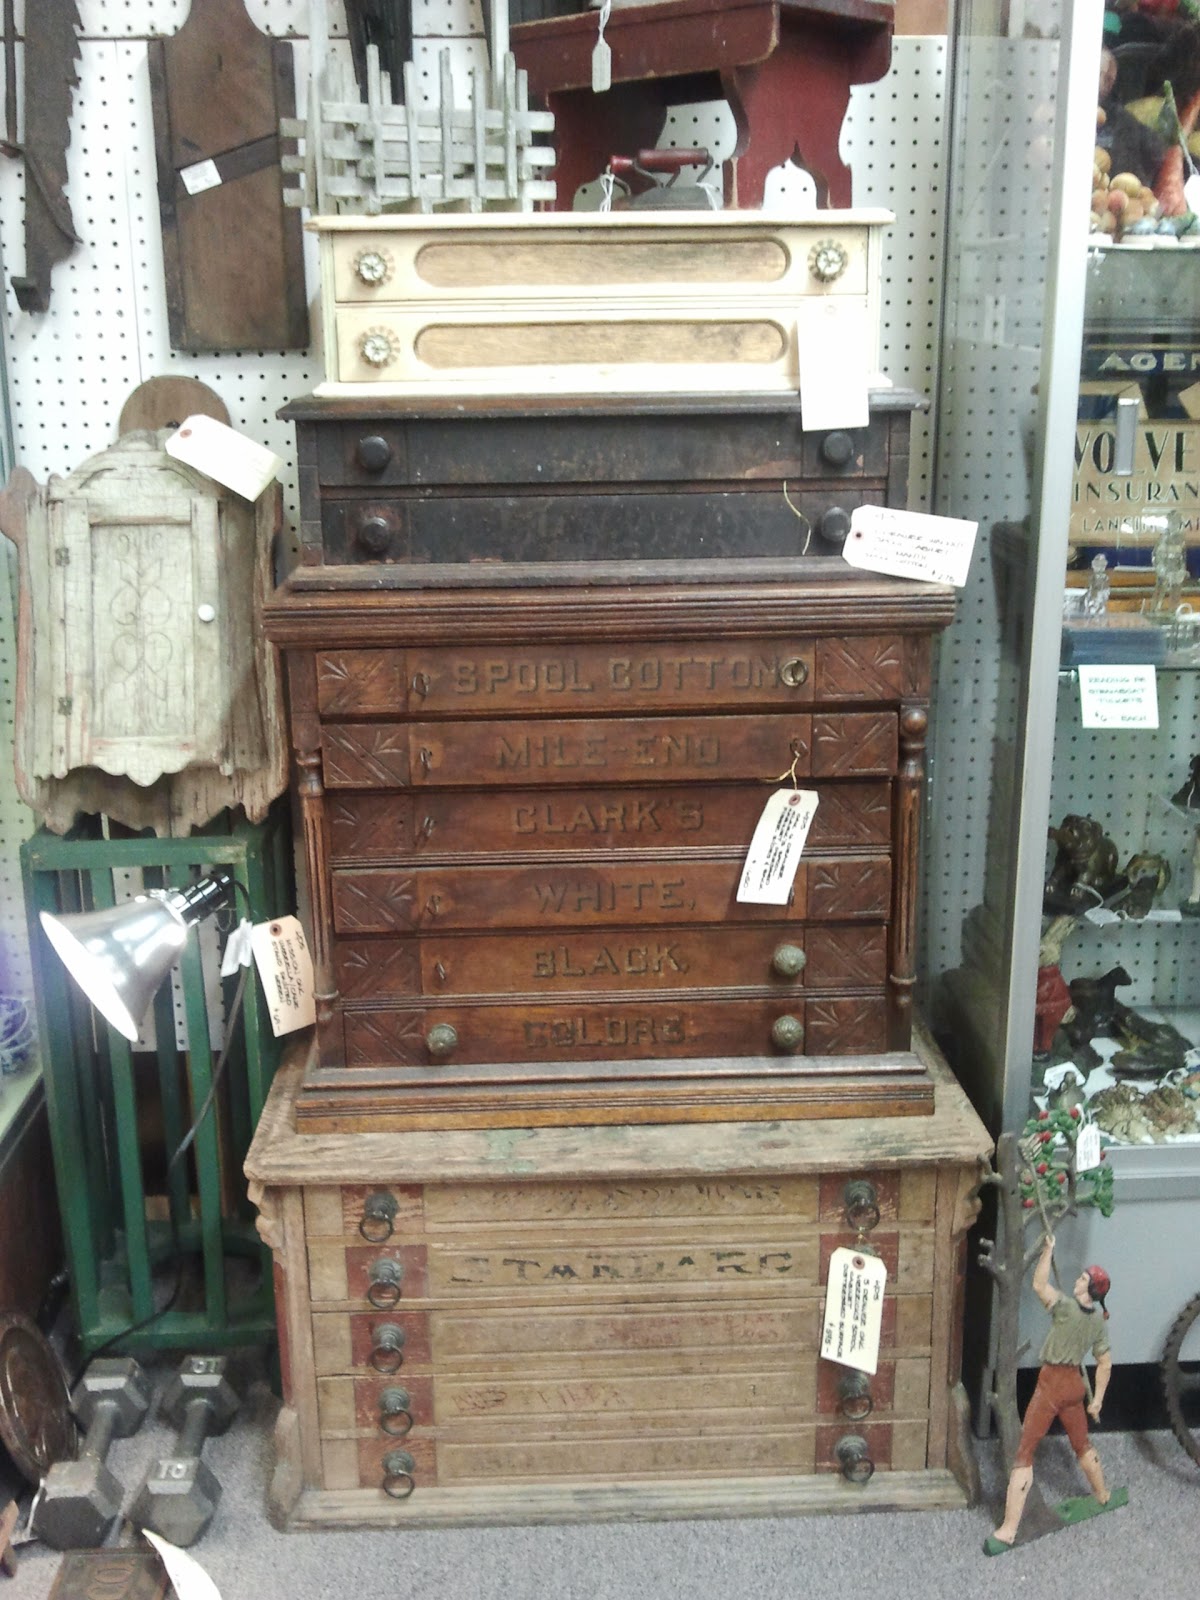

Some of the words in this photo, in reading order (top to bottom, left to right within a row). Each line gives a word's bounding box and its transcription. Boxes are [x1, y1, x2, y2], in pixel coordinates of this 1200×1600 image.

[1074, 431, 1196, 474] OVE
[1083, 517, 1166, 532] LANSI
[453, 656, 594, 694] SPOOL
[607, 654, 782, 690] COTTON
[513, 799, 705, 834] CLARK'S
[860, 1288, 868, 1326] DRAWER
[836, 1321, 844, 1358] SURFACE
[849, 1324, 857, 1352] SPOOL
